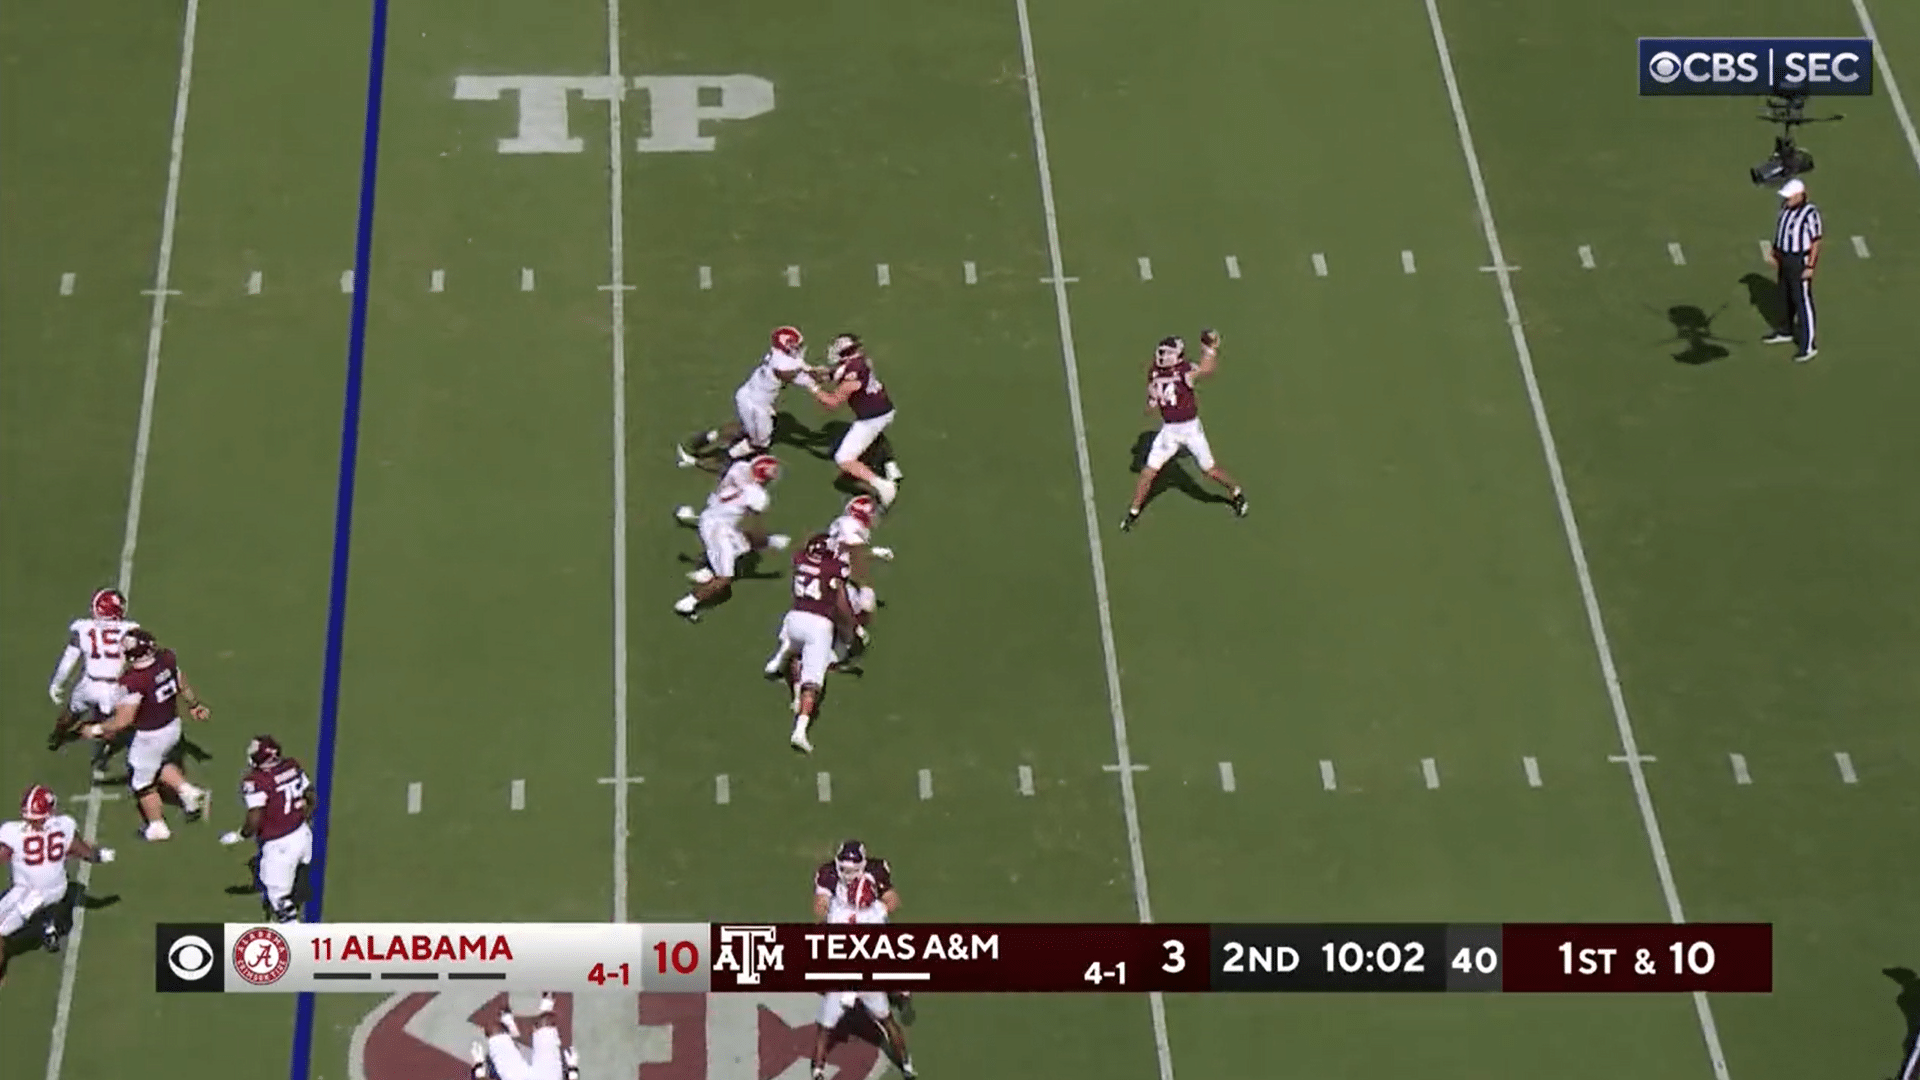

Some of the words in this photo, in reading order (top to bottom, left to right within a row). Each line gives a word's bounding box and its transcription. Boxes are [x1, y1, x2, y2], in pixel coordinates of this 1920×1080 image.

[453, 73, 776, 154] TP
[87, 627, 121, 659] 15
[22, 831, 65, 866] 96
